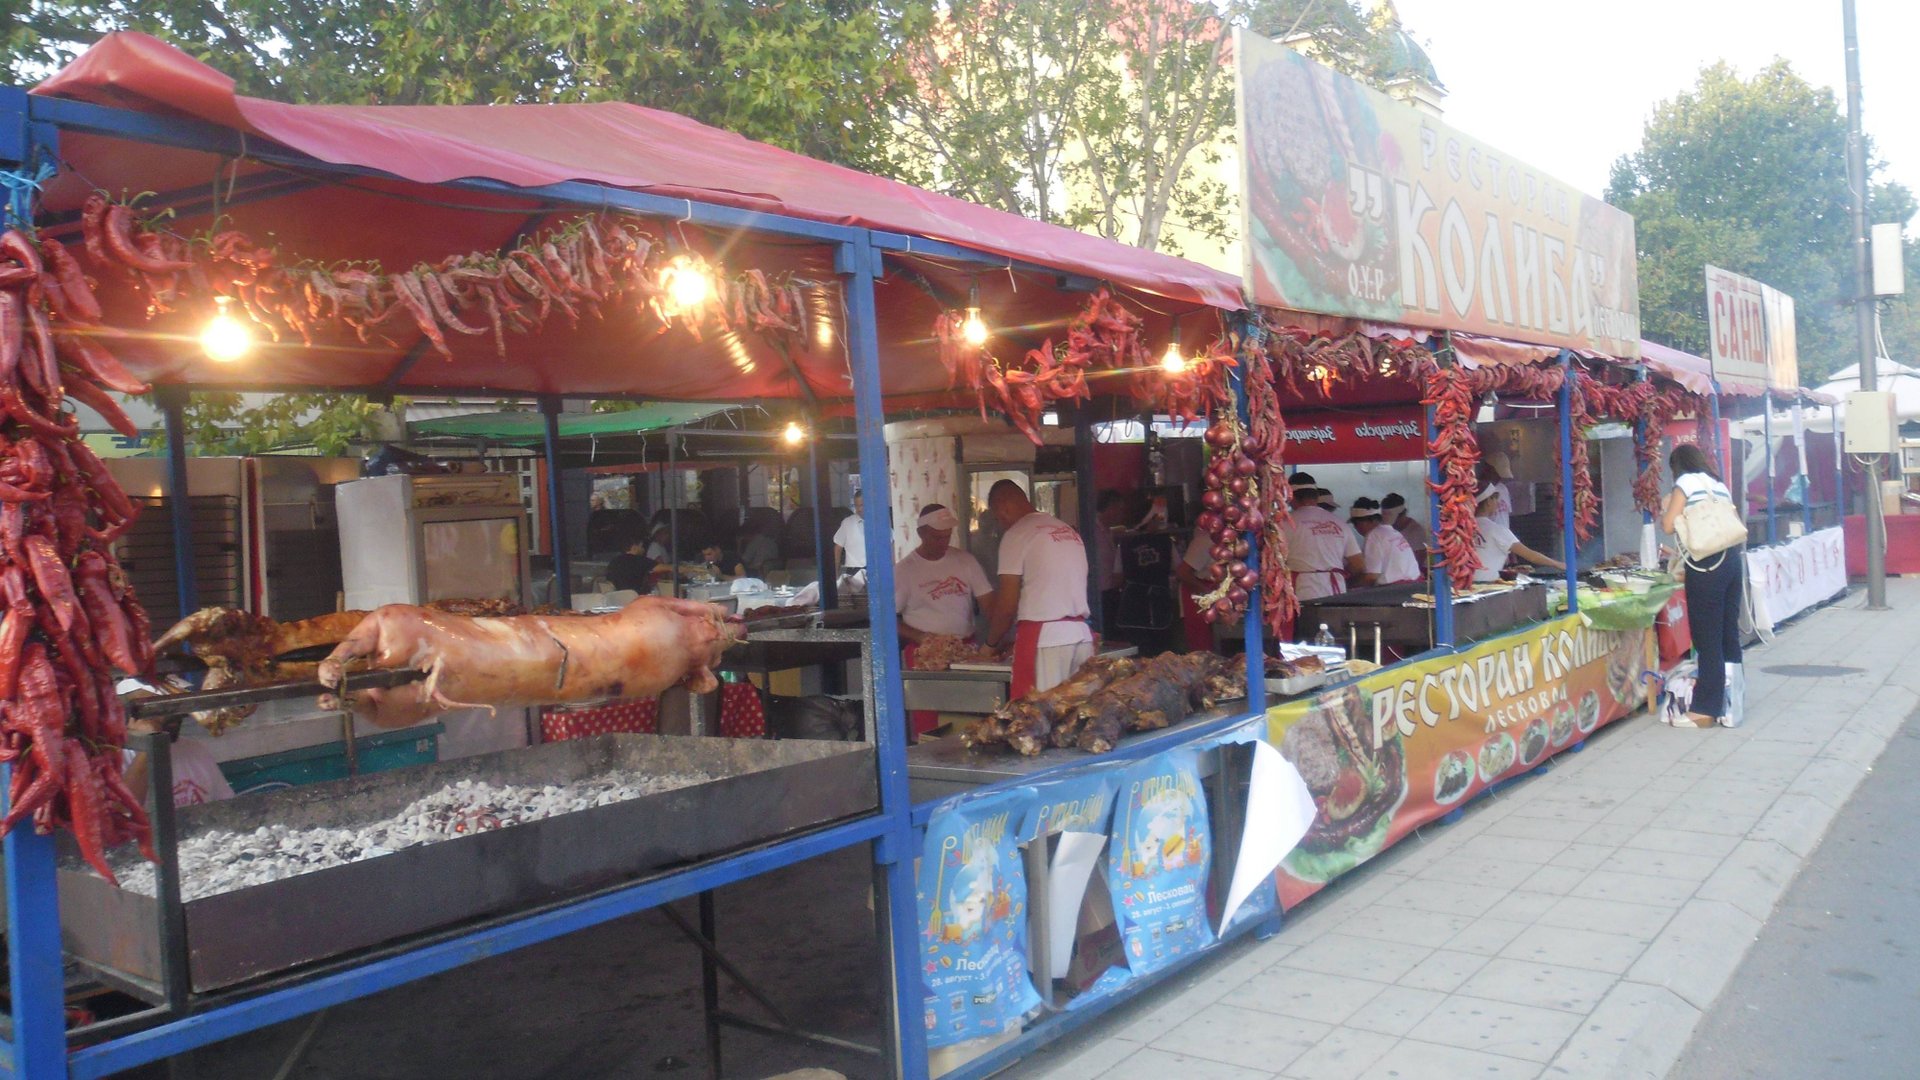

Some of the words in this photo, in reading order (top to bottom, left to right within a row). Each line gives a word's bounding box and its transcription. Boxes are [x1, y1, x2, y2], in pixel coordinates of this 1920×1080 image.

[1420, 123, 1569, 227] РЕСТОРАН
[1372, 641, 1534, 750] РЕСТОРАН
[1147, 883, 1196, 904] Лесковац
